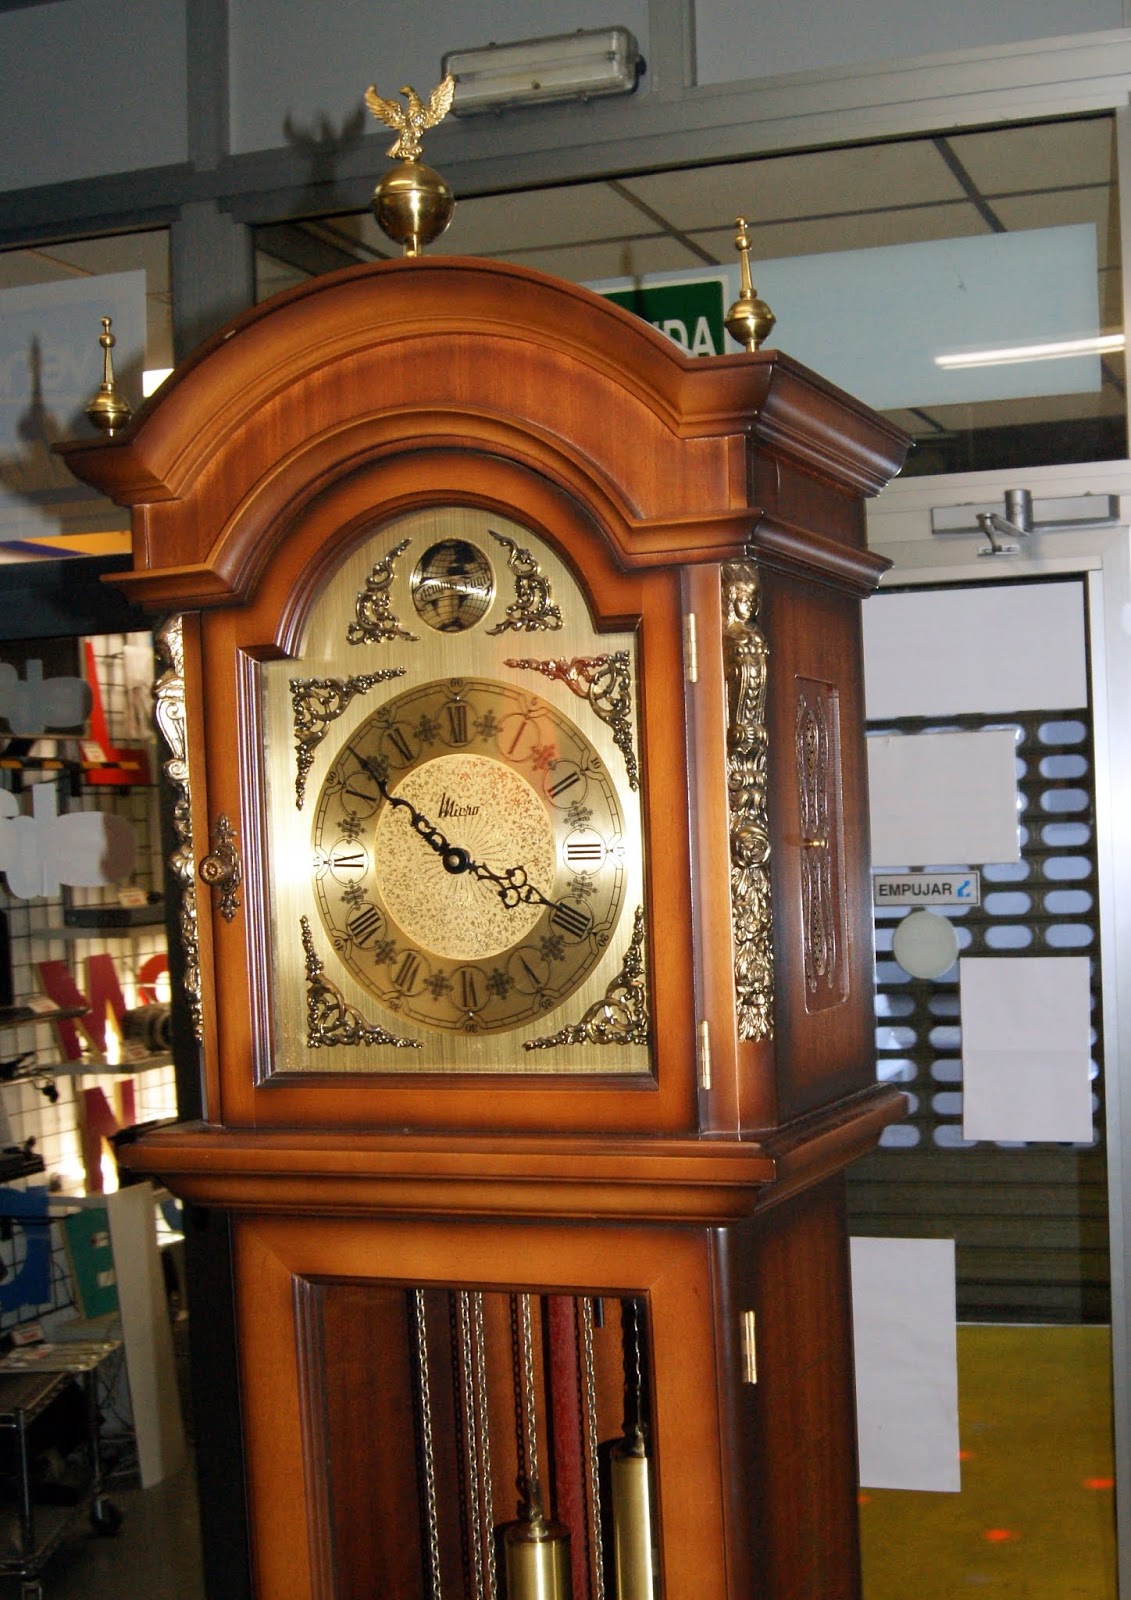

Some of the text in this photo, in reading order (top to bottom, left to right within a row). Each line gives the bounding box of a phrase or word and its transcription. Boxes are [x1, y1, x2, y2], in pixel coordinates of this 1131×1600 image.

[447, 704, 468, 744] XII
[547, 770, 580, 799] II
[438, 792, 480, 818] Micro
[567, 843, 602, 861] III
[879, 882, 952, 896] EMPUJAR
